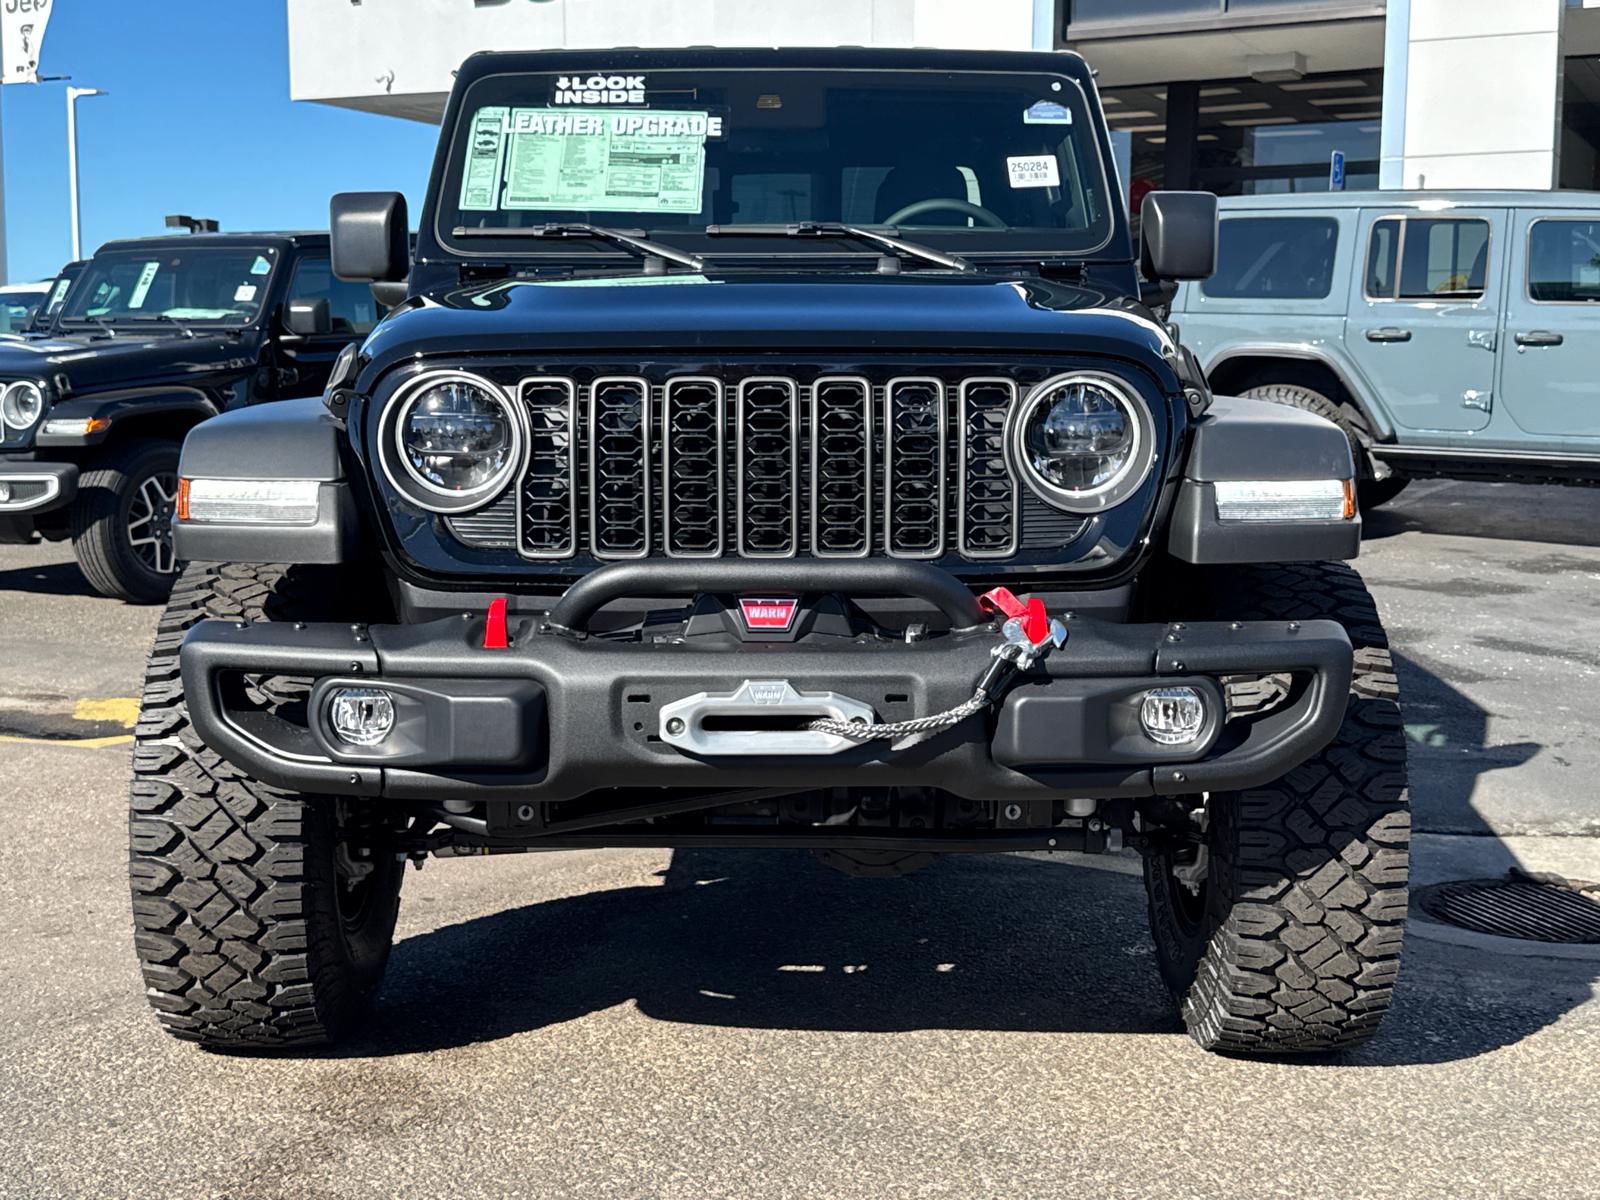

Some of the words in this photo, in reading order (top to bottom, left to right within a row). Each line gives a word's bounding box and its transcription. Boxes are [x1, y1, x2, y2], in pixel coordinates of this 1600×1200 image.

[571, 75, 646, 90] LOOK
[555, 90, 645, 104] INSIDE
[502, 114, 605, 136] LEATHER
[610, 116, 722, 137] UPGRADE
[1011, 162, 1048, 173] 250284
[749, 607, 786, 618] WARN
[754, 690, 781, 700] WARN
